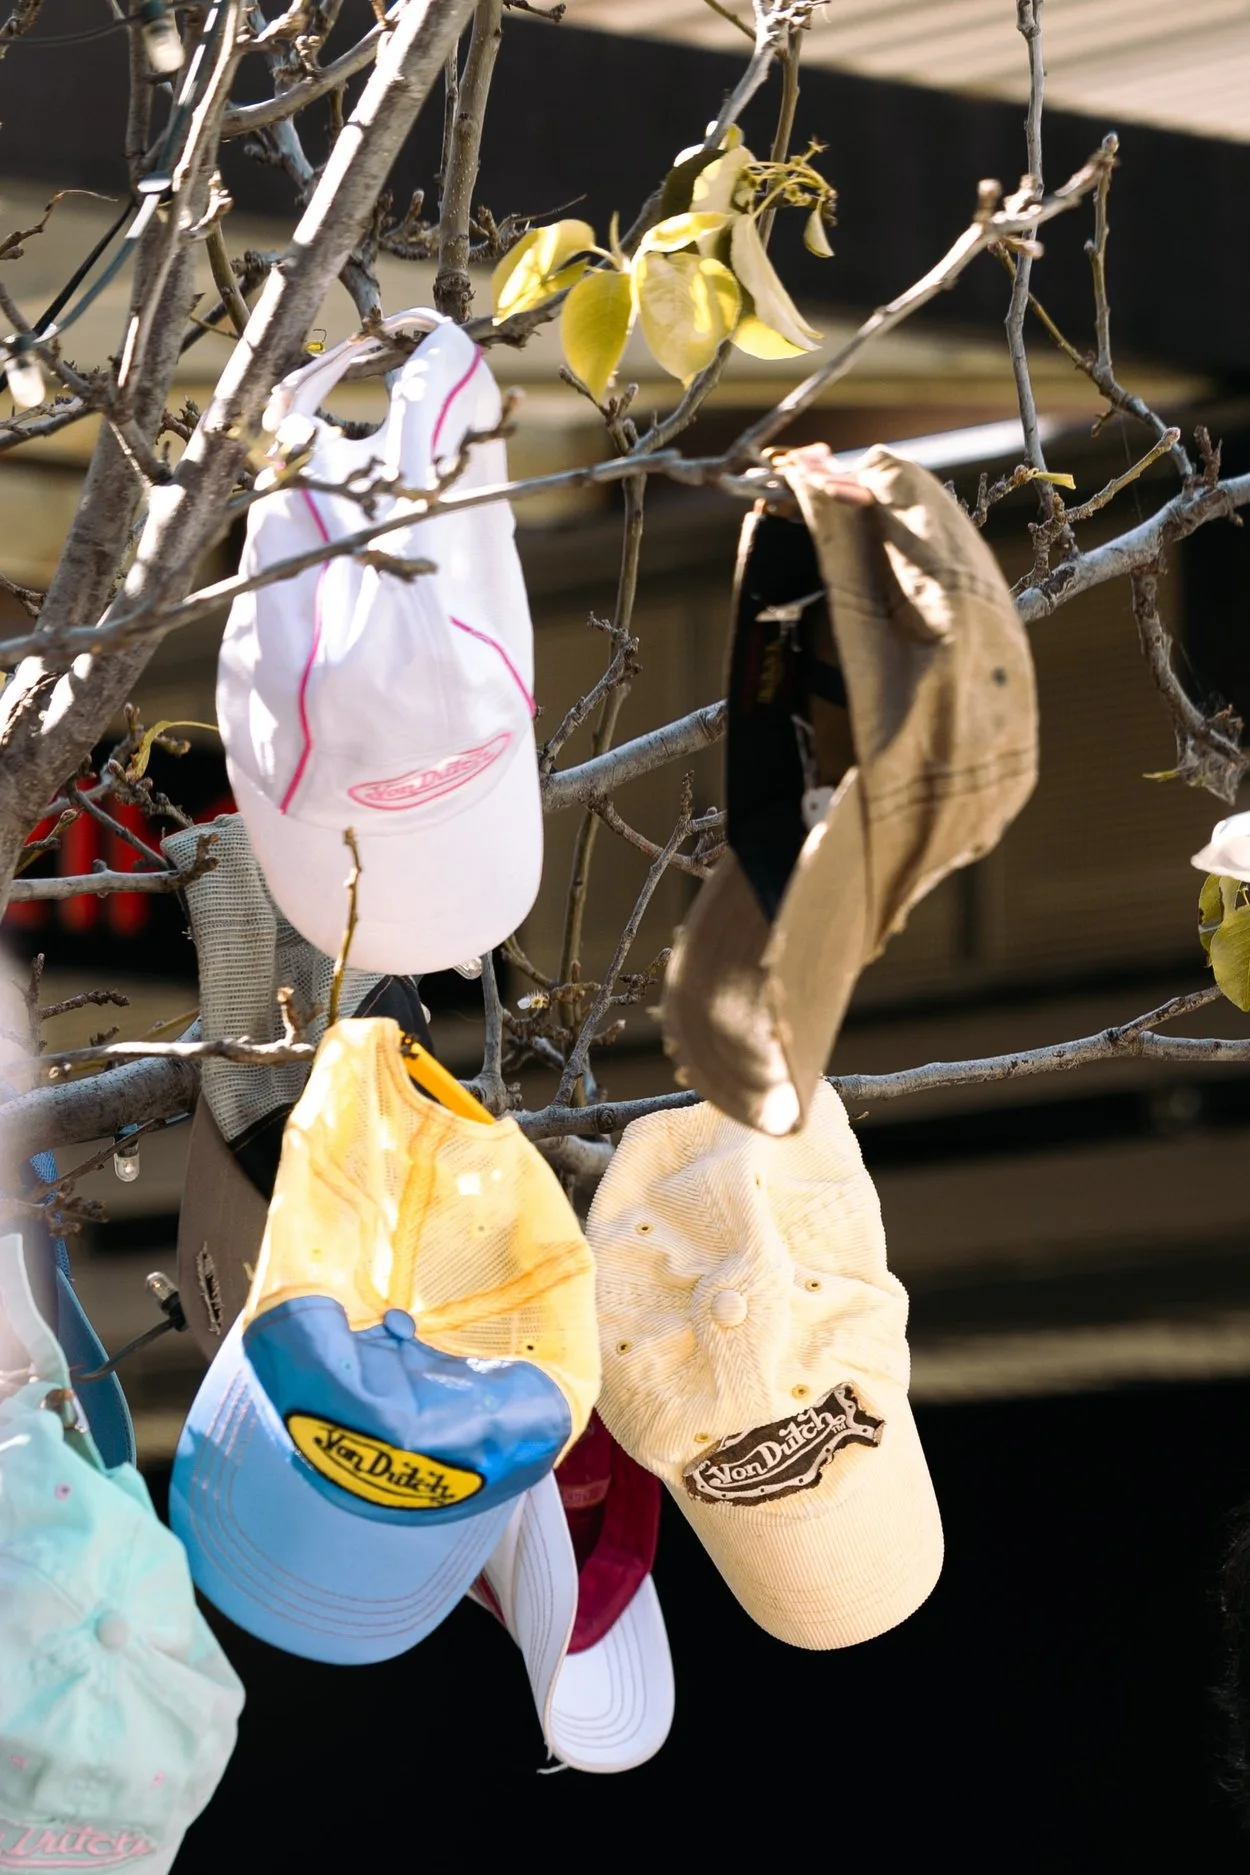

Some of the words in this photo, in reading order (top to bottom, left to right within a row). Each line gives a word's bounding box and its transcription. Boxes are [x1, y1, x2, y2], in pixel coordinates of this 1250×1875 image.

[313, 1427, 366, 1472] Von
[367, 1450, 456, 1500] Dutch
[705, 1463, 768, 1485] Von
[760, 1407, 846, 1469] Dutch
